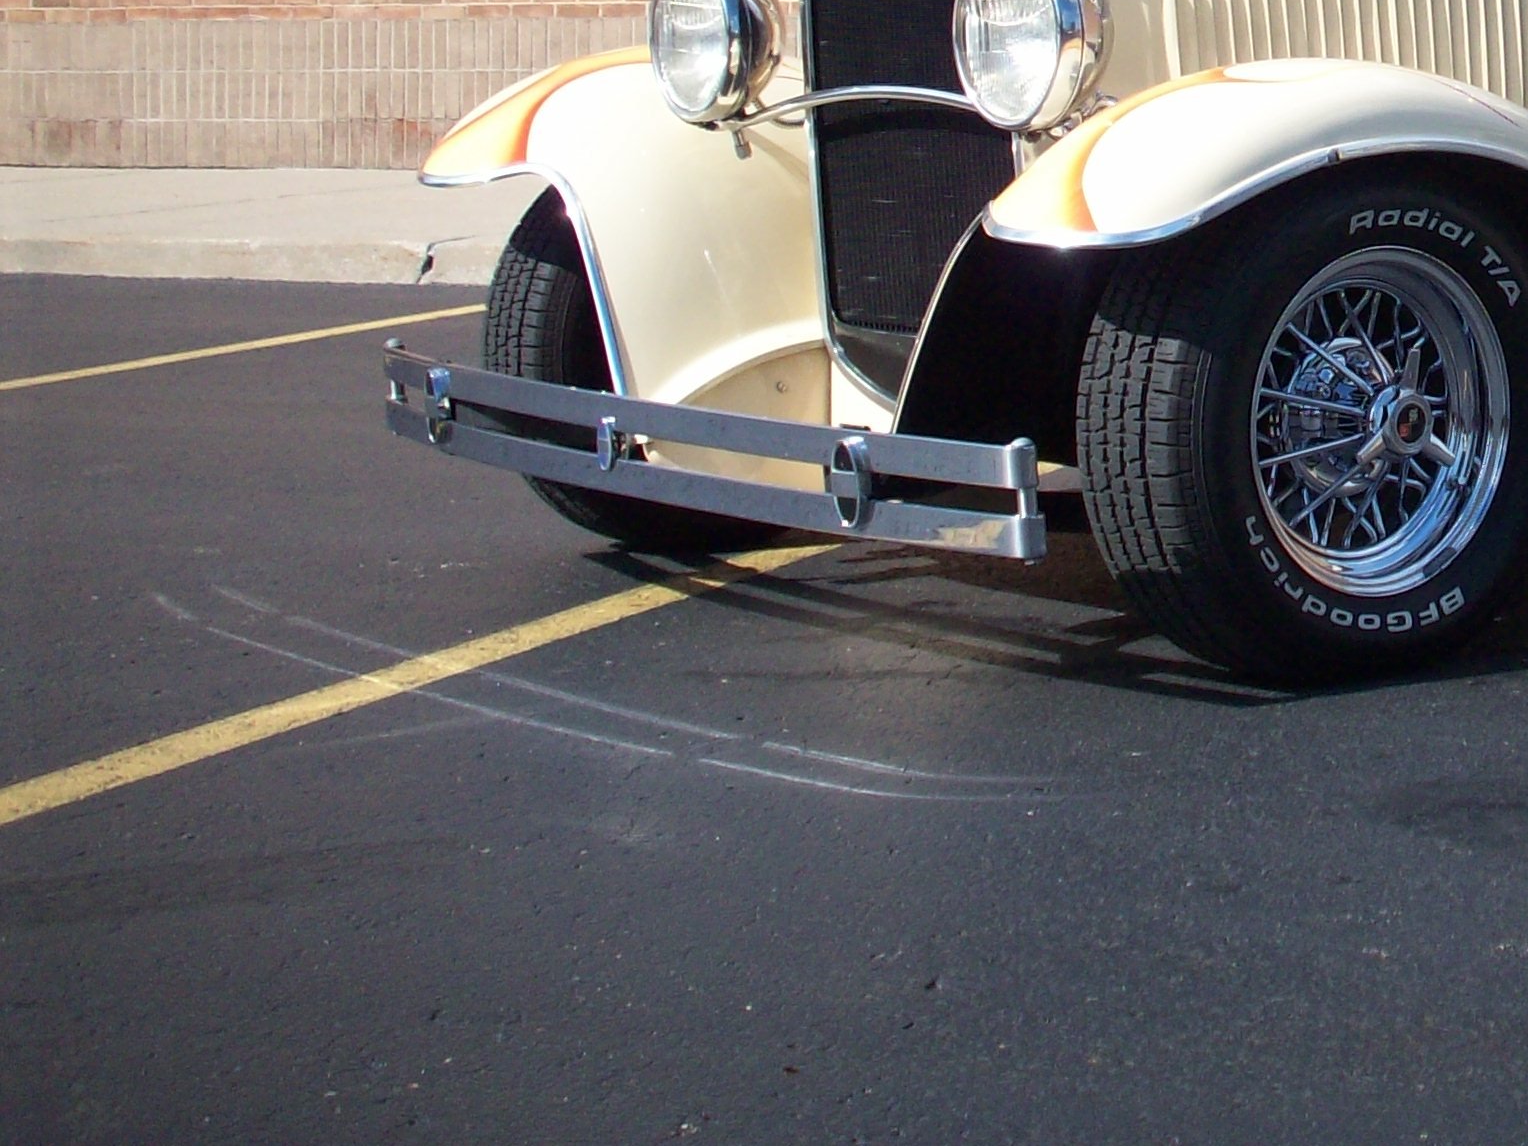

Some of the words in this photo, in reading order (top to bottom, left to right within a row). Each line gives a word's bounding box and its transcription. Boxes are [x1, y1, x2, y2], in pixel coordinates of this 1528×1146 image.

[1349, 208, 1475, 248] Radial
[1480, 245, 1521, 307] T/A
[1245, 515, 1465, 633] BFGoodrich
